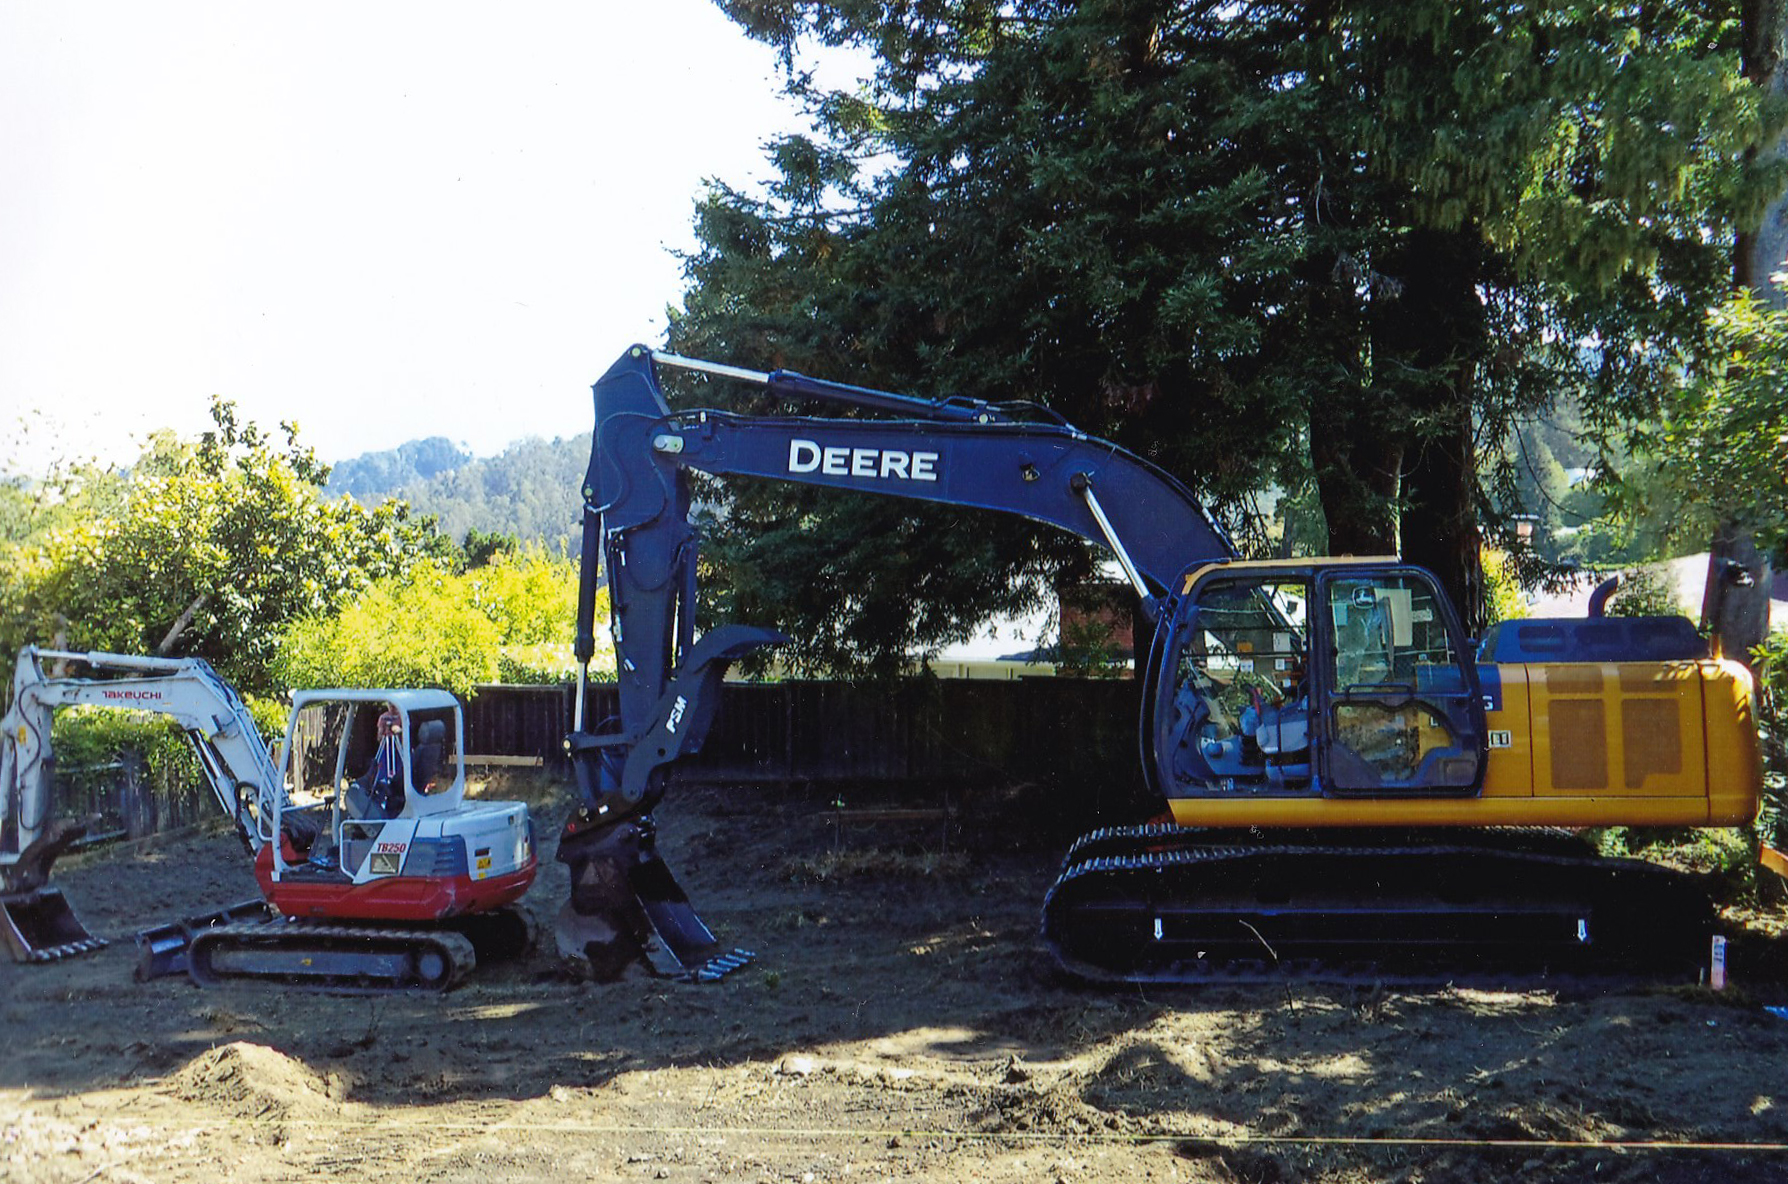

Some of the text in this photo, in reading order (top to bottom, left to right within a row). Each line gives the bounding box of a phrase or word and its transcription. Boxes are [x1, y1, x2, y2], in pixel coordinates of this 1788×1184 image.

[788, 438, 939, 481] DEERE
[665, 694, 688, 734] PSM
[377, 842, 407, 853] TB250
